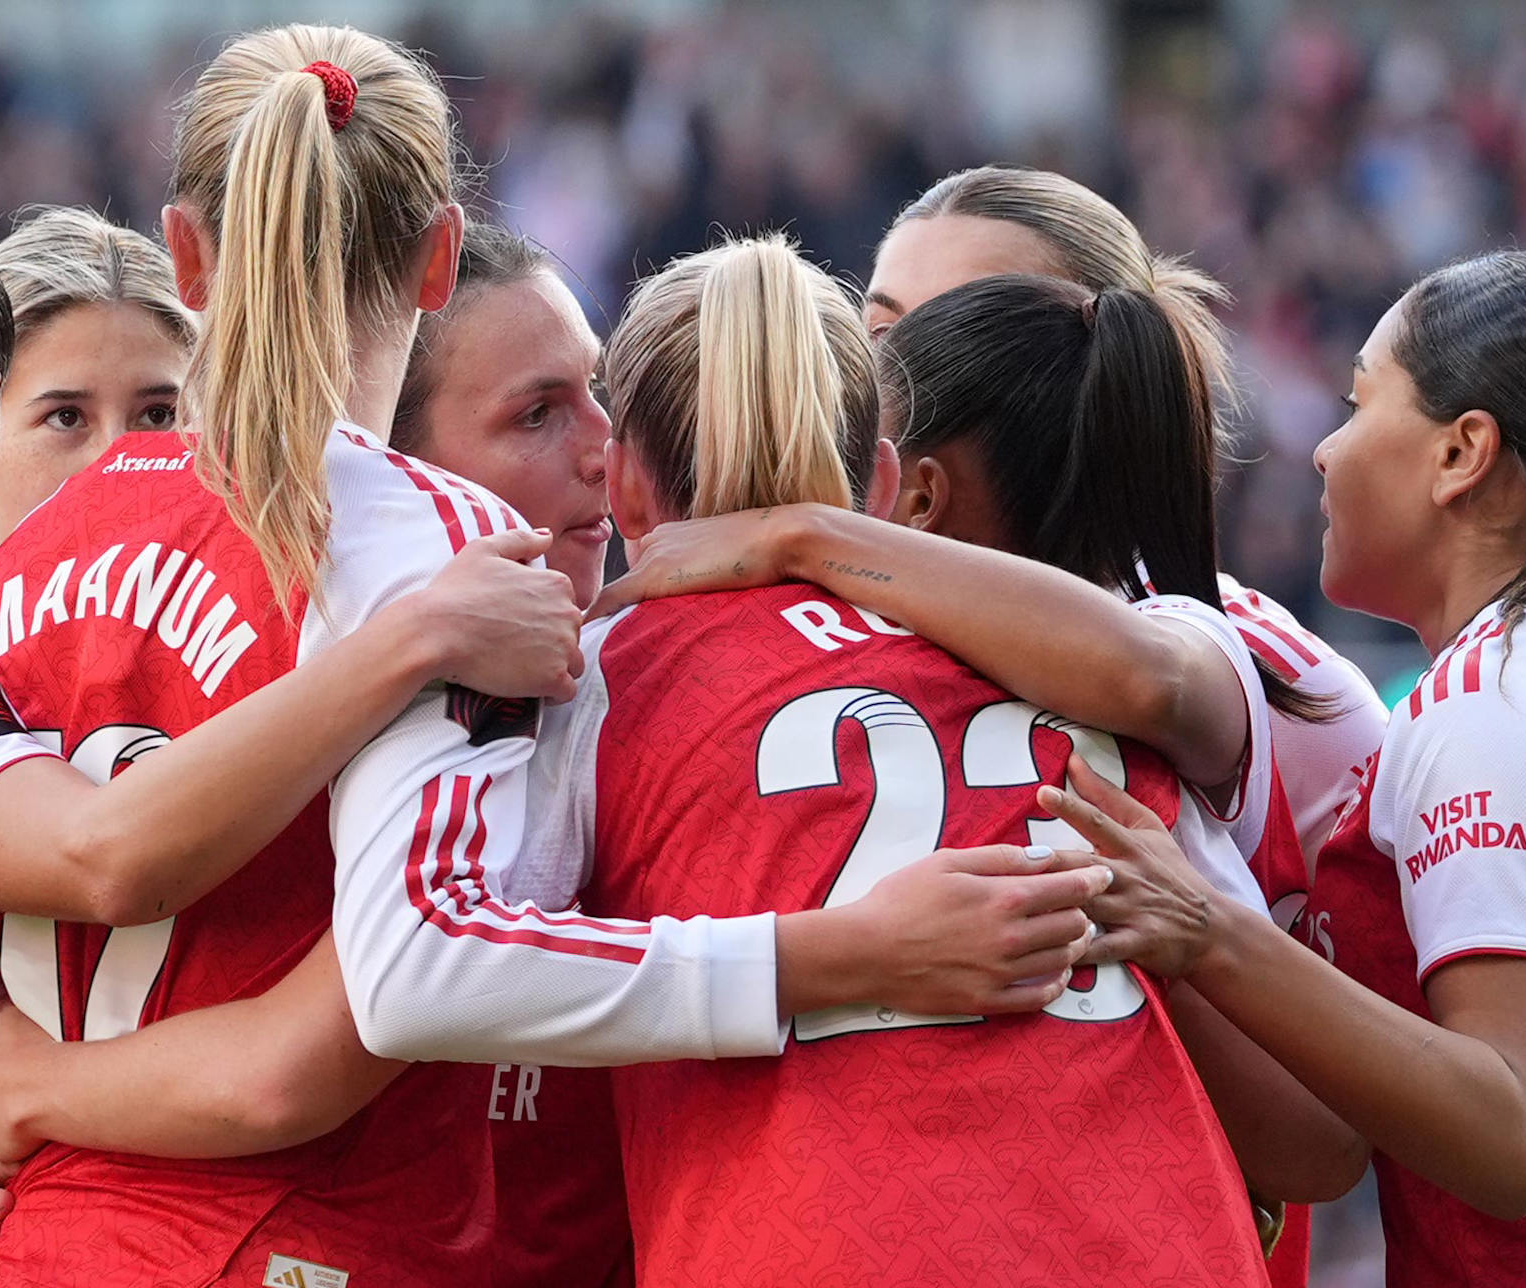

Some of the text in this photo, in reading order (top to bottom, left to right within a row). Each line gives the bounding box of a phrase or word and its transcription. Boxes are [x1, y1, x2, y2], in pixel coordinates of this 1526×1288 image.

[102, 450, 194, 475] Arsenal
[1419, 790, 1492, 836] VISIT
[487, 1063, 542, 1122] ER
